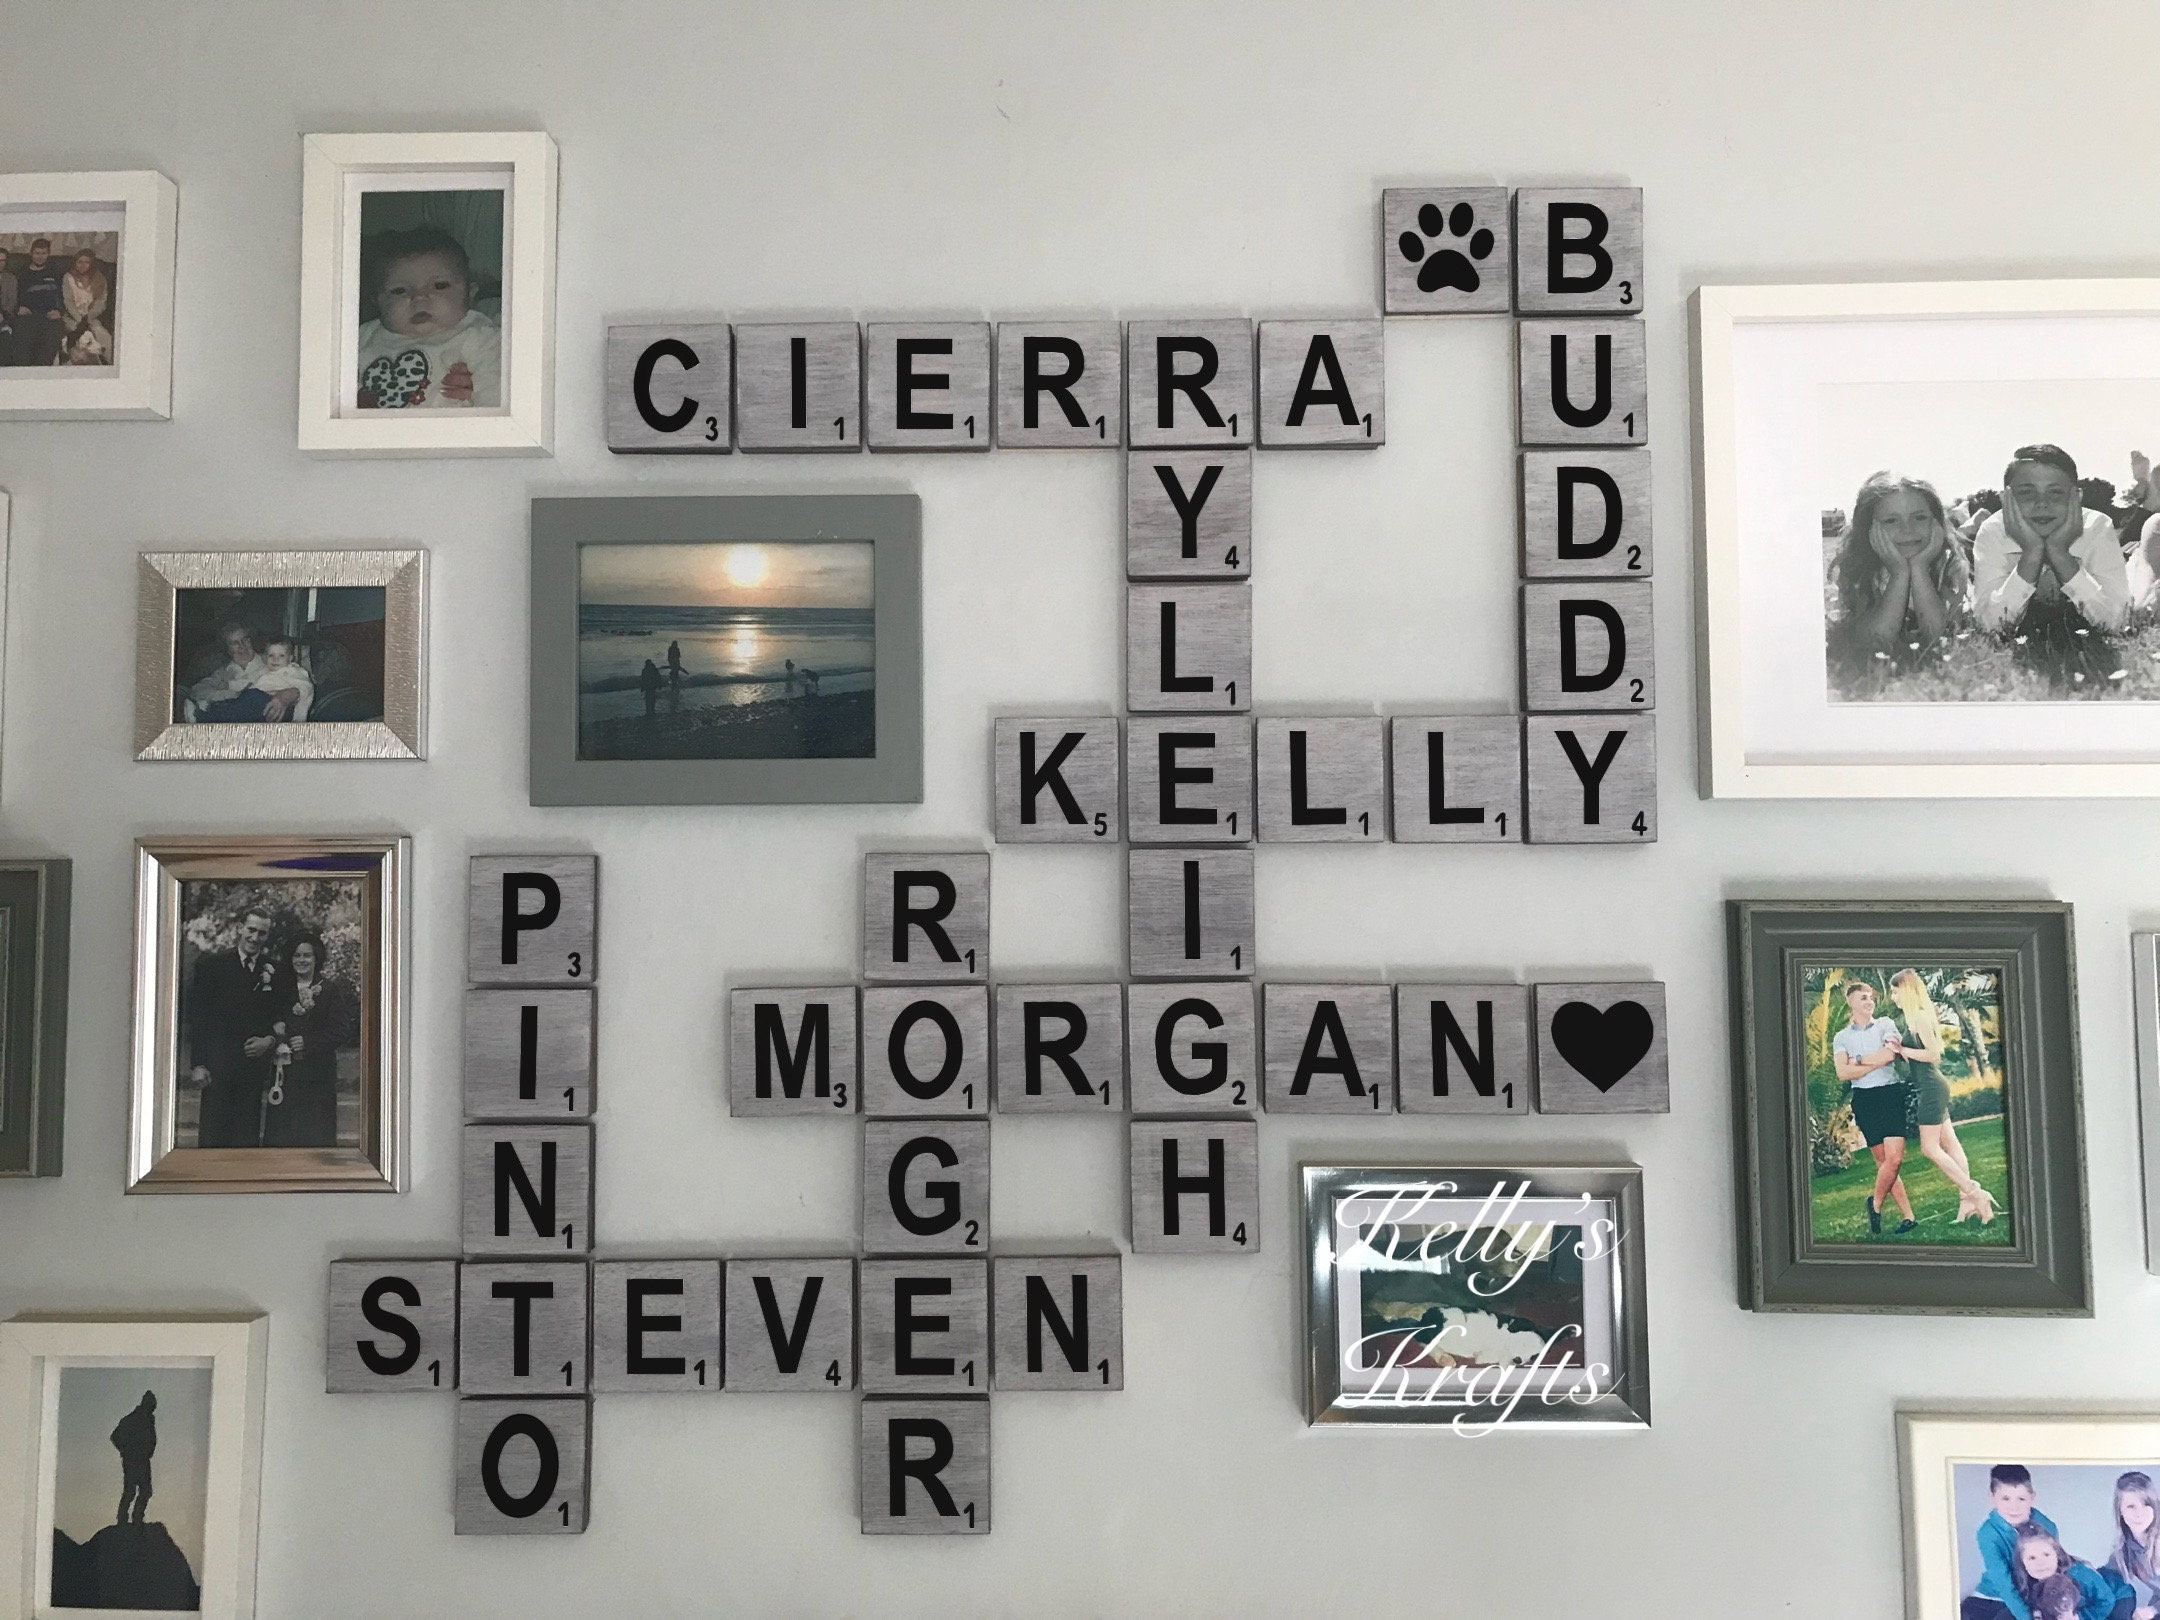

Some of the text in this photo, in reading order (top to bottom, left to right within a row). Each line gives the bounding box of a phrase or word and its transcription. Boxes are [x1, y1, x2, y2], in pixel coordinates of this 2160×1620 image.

[1618, 280, 1633, 305] 3
[633, 334, 1361, 433] CIERRA
[705, 416, 719, 442] 3
[833, 416, 845, 441] 1
[963, 415, 975, 439] 1
[1095, 415, 1105, 439] 1
[1227, 413, 1238, 437] 1
[1362, 413, 1372, 438] 1
[1622, 412, 1634, 438] 1
[1547, 202, 1628, 826] BUDDY
[1224, 545, 1240, 570] 4
[1627, 544, 1642, 570] 2
[1224, 681, 1236, 706] 1
[1629, 678, 1645, 703] 2
[1019, 730, 1628, 826] KELLY
[1153, 334, 1229, 1237] RYLEIGH
[1093, 812, 1108, 837] 5
[1226, 811, 1237, 836] 1
[1358, 811, 1369, 836] 1
[1494, 812, 1506, 837] 1
[1631, 811, 1648, 837] 4
[567, 951, 582, 978] 3
[964, 948, 975, 974] 1
[1230, 945, 1241, 970] 1
[754, 999, 1496, 1100] MORGAN
[563, 1087, 575, 1112] 1
[833, 1082, 848, 1109] 3
[962, 1083, 973, 1110] 1
[1098, 1079, 1110, 1106] 1
[1231, 1080, 1247, 1106] 2
[1368, 1083, 1379, 1110] 1
[1501, 1082, 1513, 1109] 1
[481, 872, 561, 1519] PINTO
[887, 870, 964, 1517] ROGER
[561, 1223, 573, 1250] 1
[964, 1219, 979, 1246] 2
[1232, 1221, 1247, 1246] 4
[356, 1274, 1089, 1378] STEVEN
[427, 1359, 440, 1387] 1
[560, 1360, 573, 1387] 1
[693, 1359, 706, 1386] 1
[825, 1359, 842, 1387] 4
[961, 1360, 975, 1387] 1
[1096, 1358, 1109, 1385] 1
[557, 1500, 569, 1527] 1
[963, 1501, 975, 1529] 1
